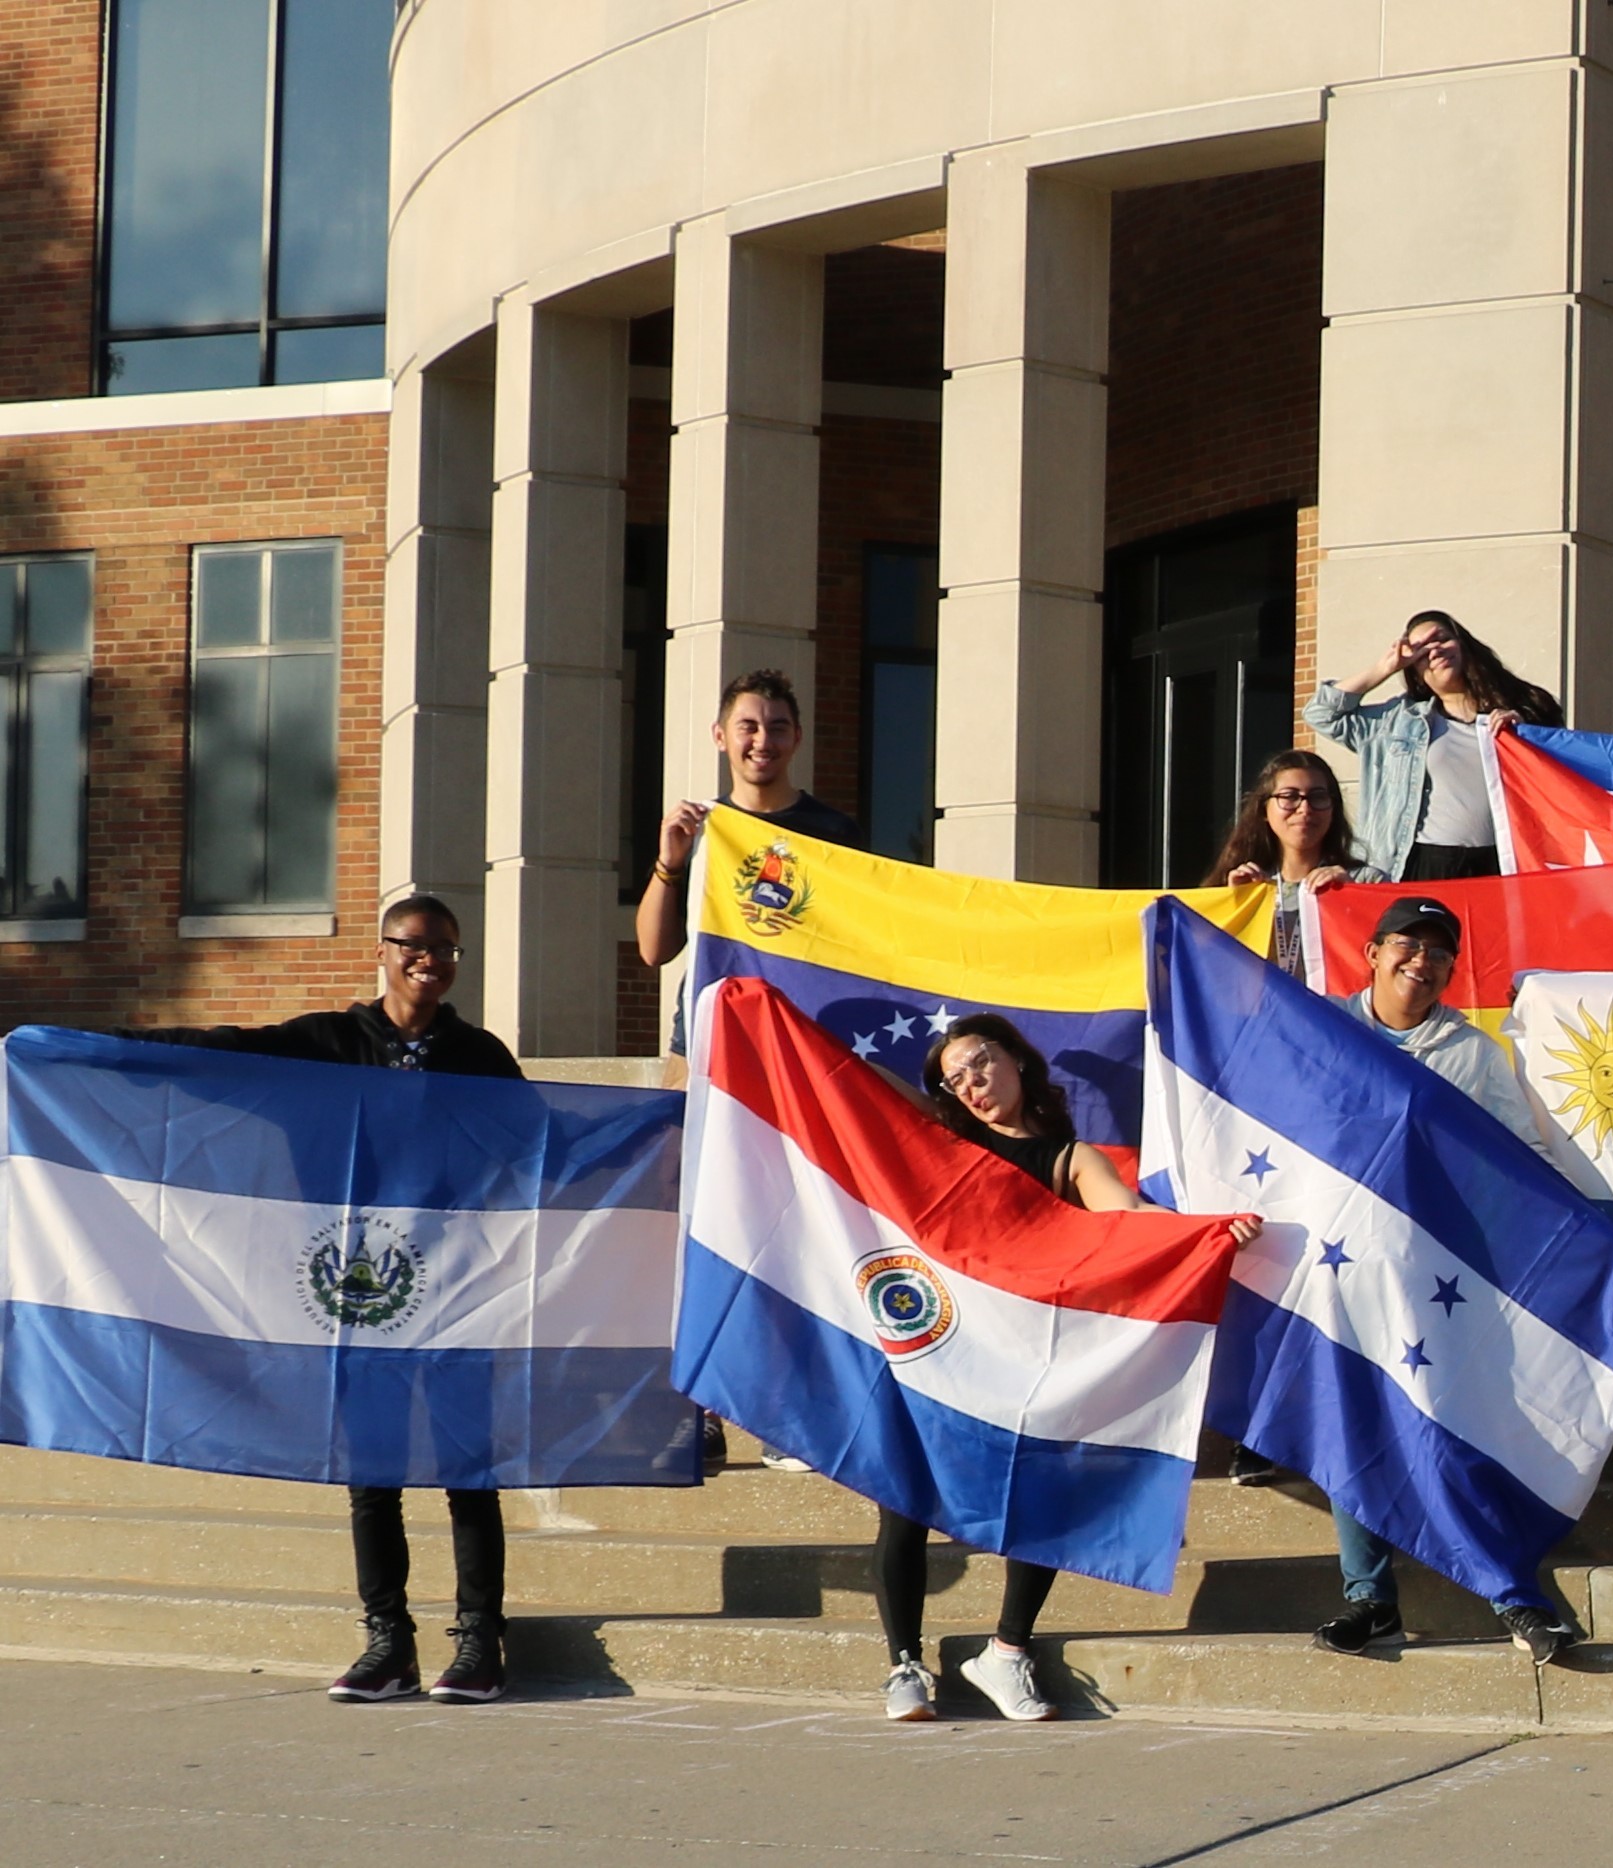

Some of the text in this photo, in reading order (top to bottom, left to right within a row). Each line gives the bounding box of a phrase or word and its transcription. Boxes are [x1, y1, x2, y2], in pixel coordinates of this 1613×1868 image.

[375, 1218, 391, 1229] EN
[393, 1227, 408, 1241] LA
[301, 1245, 313, 1257] EL
[295, 1261, 306, 1275] DE
[380, 1298, 422, 1336] CENTRAL
